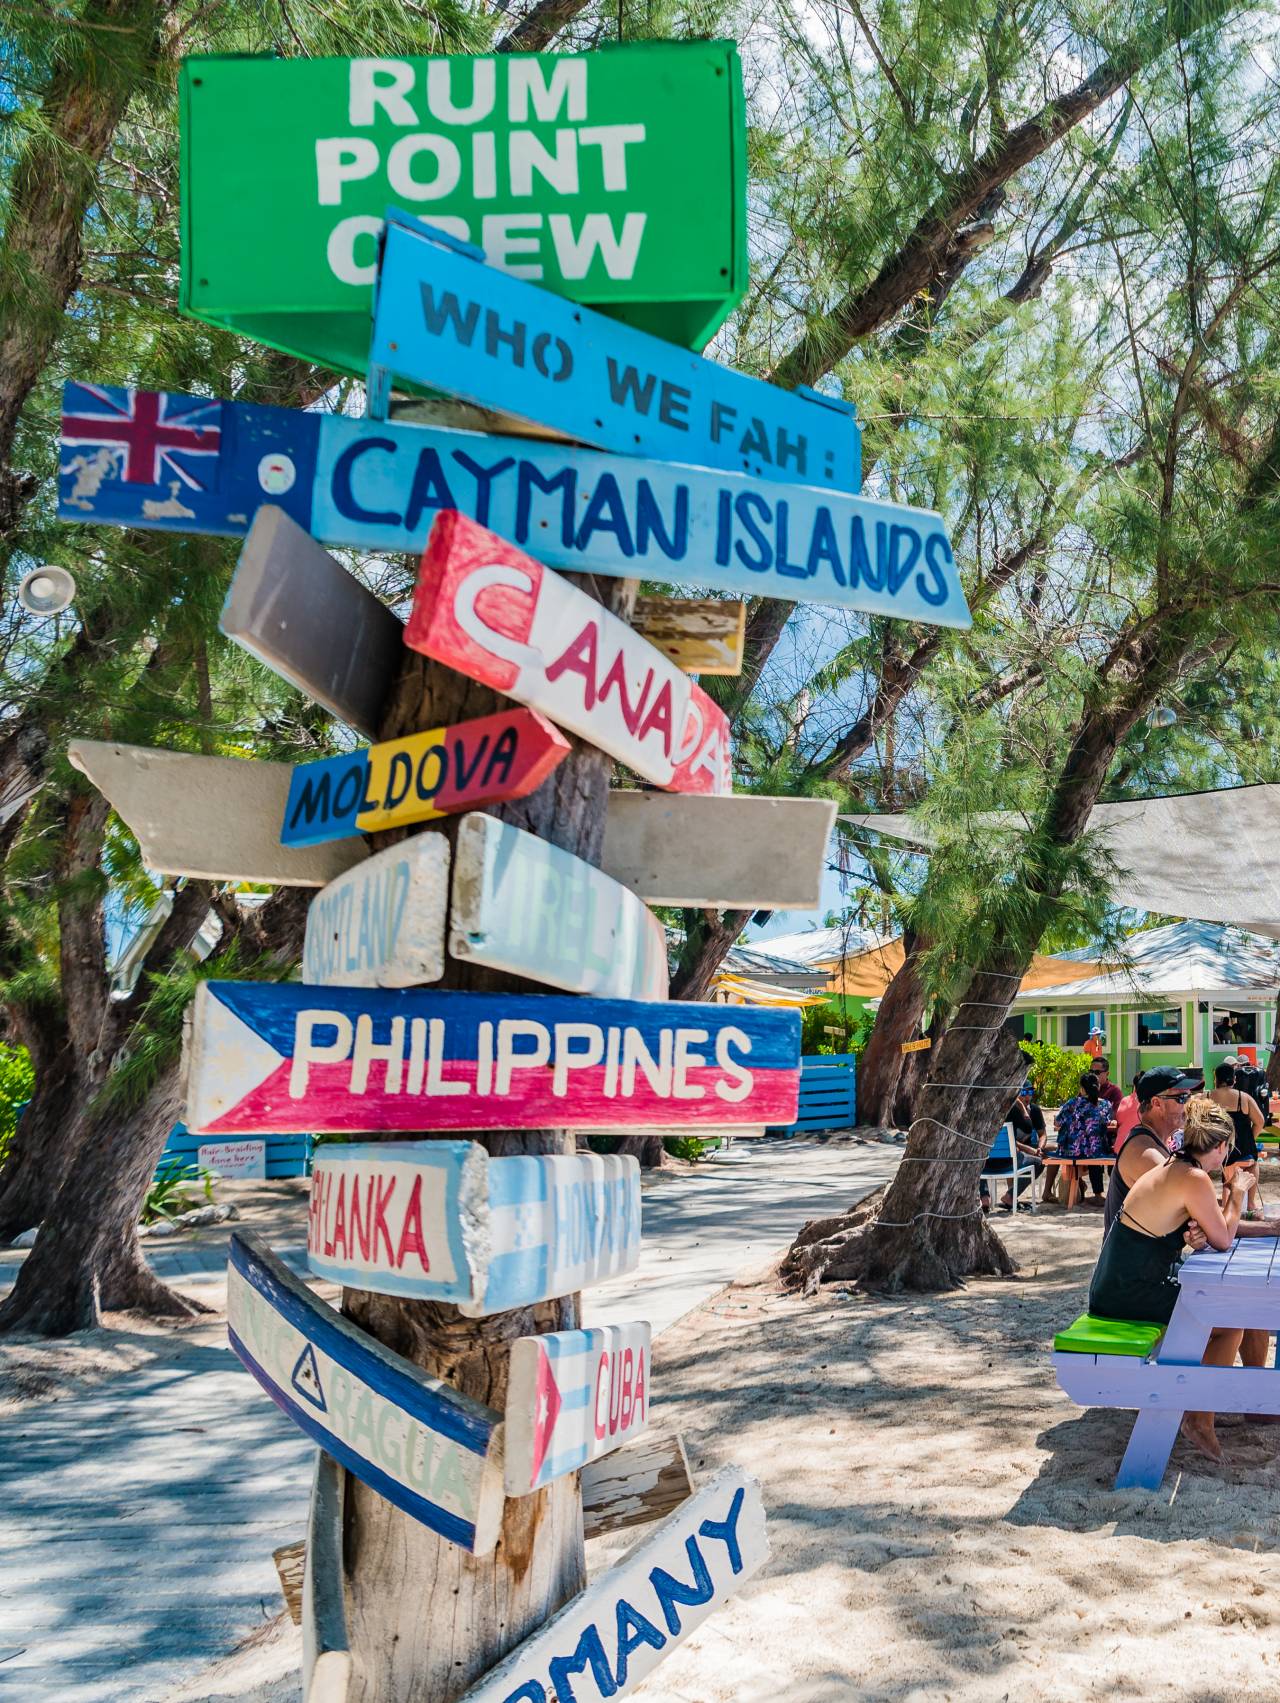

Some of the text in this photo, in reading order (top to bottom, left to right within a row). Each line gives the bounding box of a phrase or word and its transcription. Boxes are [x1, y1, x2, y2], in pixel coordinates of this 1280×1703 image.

[348, 58, 588, 127] RUM
[315, 123, 646, 206] POINT
[327, 212, 648, 286] CEW
[419, 280, 574, 382] WHO
[607, 356, 692, 432] WE
[331, 436, 953, 607] CAYMAN ISLANDS
[453, 563, 727, 796] CANADA
[289, 726, 519, 830] MOLDOVA
[288, 1008, 754, 1102] PHILIPPINES
[324, 1172, 430, 1274] LANKA
[594, 1346, 645, 1441] CUBA
